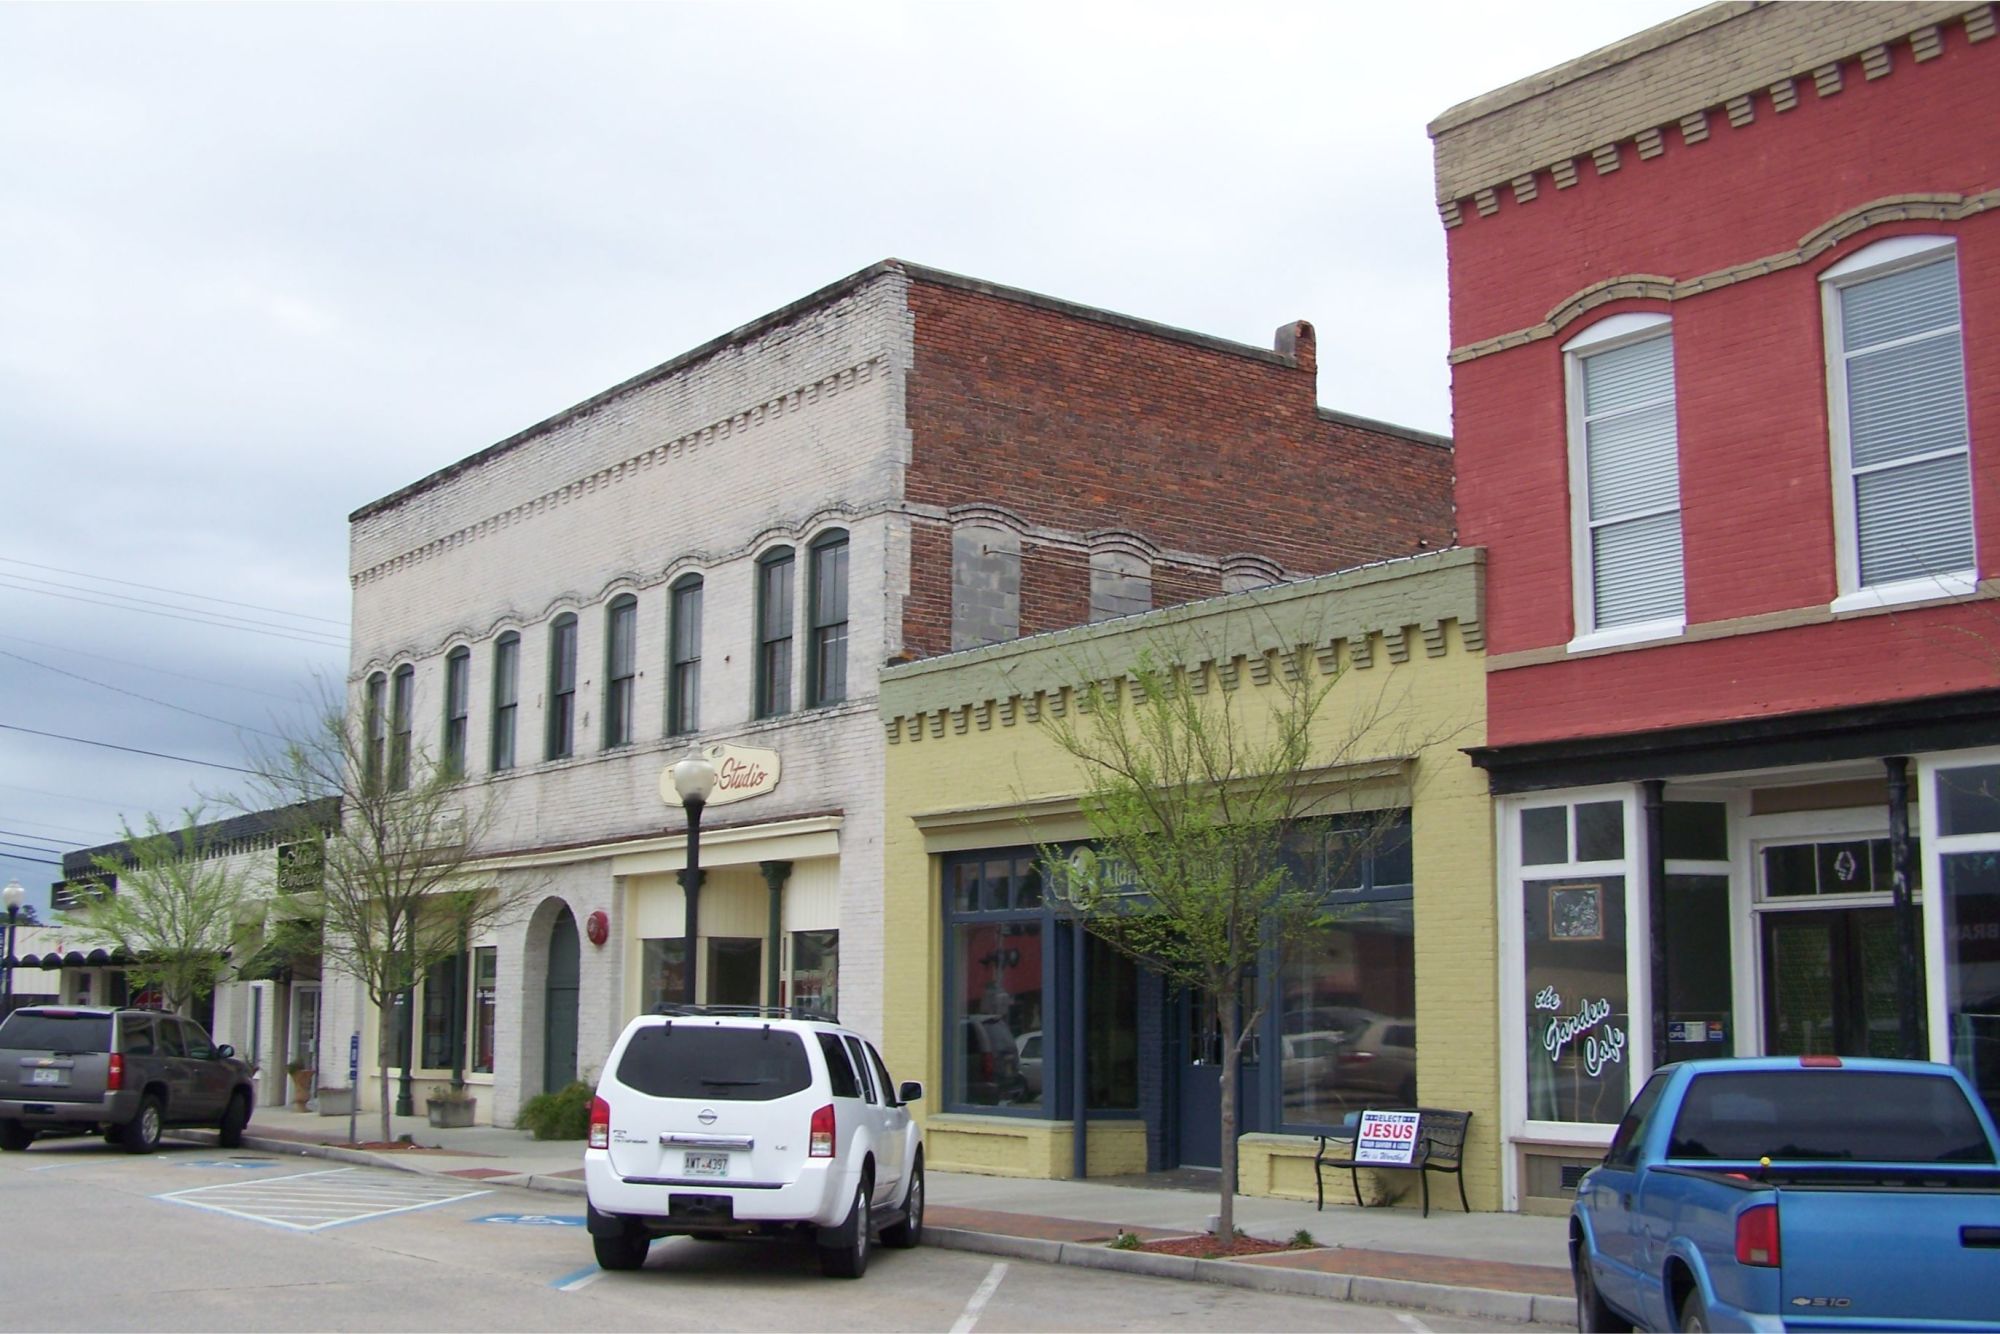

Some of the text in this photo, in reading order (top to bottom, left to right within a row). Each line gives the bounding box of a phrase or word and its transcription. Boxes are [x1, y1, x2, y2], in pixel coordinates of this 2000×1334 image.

[719, 757, 768, 790] Studio
[1534, 985, 1560, 1010] the
[1542, 998, 1610, 1062] Garden
[1583, 1024, 1625, 1077] Cafe
[1363, 1123, 1413, 1139] JESUS
[1378, 1114, 1402, 1123] ELECT
